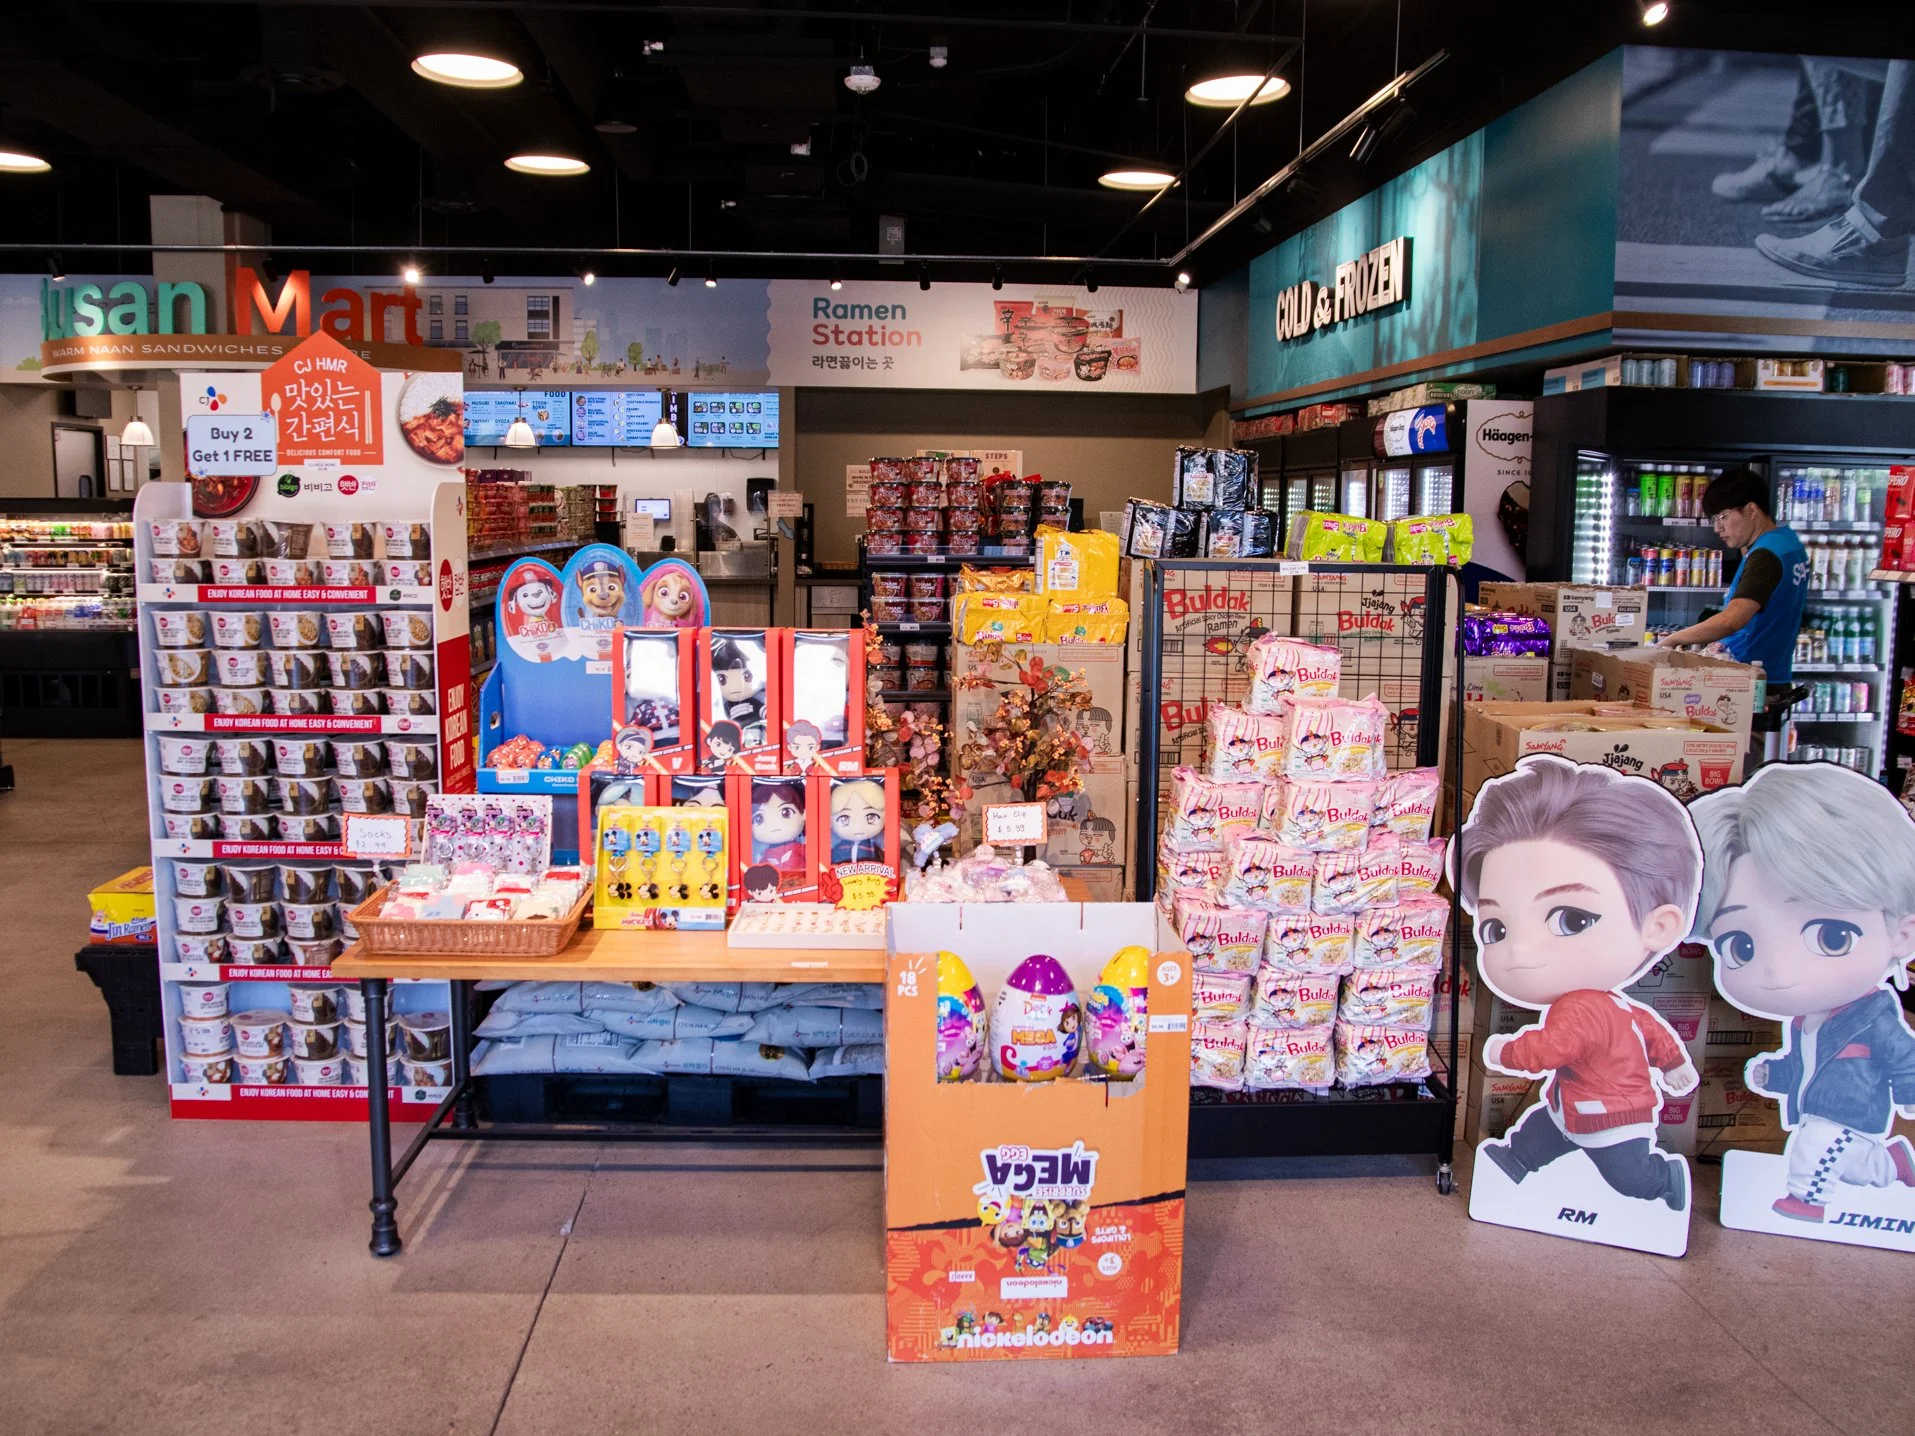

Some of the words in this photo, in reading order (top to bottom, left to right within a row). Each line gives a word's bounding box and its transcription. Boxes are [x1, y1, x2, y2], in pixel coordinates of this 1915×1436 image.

[1276, 280, 1312, 343] COLD
[1314, 286, 1331, 329] &
[1334, 236, 1414, 323] FROZEN
[236, 267, 424, 349] Mart
[812, 296, 907, 321] Ramen
[812, 323, 922, 347] Station
[52, 346, 85, 358] WARM
[89, 344, 133, 355] NAAN
[142, 344, 283, 355] SANDWICHES
[294, 360, 312, 374] CJ
[315, 357, 348, 373] HMR
[812, 354, 879, 371] 라면끓이는
[882, 355, 895, 370] 곳
[285, 379, 360, 411] 맛있는
[285, 411, 360, 442] 간편식
[211, 427, 239, 444] Buy
[243, 427, 254, 440] 2
[193, 450, 219, 462] Get
[223, 450, 230, 462] 1
[234, 450, 273, 462] FREE
[304, 482, 333, 493] 비비고
[207, 589, 227, 599] ENJOY
[229, 589, 254, 599] KOREAN
[256, 590, 273, 599] FOOD
[274, 590, 282, 599] AT
[283, 590, 302, 599] HOME
[303, 590, 320, 599] EASY
[322, 590, 326, 599] &
[327, 590, 368, 599] CONVENIENT
[1163, 585, 1250, 620] Buldak
[1175, 616, 1202, 633] Artificial
[1202, 614, 1216, 623] Spicy
[1206, 620, 1238, 634] Ramen
[1336, 610, 1396, 633] Buldak
[1297, 667, 1340, 683] Buldak
[1660, 676, 1693, 687] SAMYANG
[447, 683, 465, 712] ENJOY
[1685, 705, 1718, 718] Buldak
[214, 718, 233, 727] ENJOY
[235, 718, 260, 727] KOREAN
[262, 718, 278, 727] FOOD
[279, 718, 287, 728] AT
[289, 718, 307, 728] HOME
[309, 719, 325, 728] EASY
[327, 719, 332, 728] &
[333, 719, 373, 729] CONVENIENT
[445, 709, 468, 744] KOREAN
[1171, 729, 1198, 744] Artificial
[1526, 741, 1565, 751] SAMYANG
[450, 739, 465, 770] FOOD
[754, 755, 777, 764] Jung
[671, 757, 683, 770] V
[837, 760, 860, 772] RM
[1602, 752, 1644, 772] Jjajang
[1704, 777, 1725, 785] BOWL
[1710, 770, 1721, 778] BIG
[1219, 806, 1258, 821] Buldak
[1327, 807, 1369, 823] Buldak
[359, 827, 392, 840] Socks
[222, 845, 242, 854] ENJOY
[243, 845, 268, 854] KOREAN
[269, 845, 286, 854] FOOD
[287, 845, 295, 854] AT
[296, 845, 315, 855] HOME
[316, 845, 332, 855] EASY
[333, 846, 339, 855] &
[836, 866, 858, 879] NEW
[858, 864, 896, 878] ARRIVAL
[1272, 865, 1313, 879] Buldak
[1357, 865, 1399, 882] Buldak
[1401, 862, 1438, 881] Buldak
[105, 921, 123, 941] Jin
[1309, 923, 1352, 939] Buldak
[1401, 926, 1443, 940] Buldak
[1217, 932, 1260, 947] Buldak
[229, 969, 248, 977] ENJOY
[250, 969, 274, 977] KOREAN
[276, 969, 292, 978] FOOD
[293, 970, 301, 978] AT
[302, 970, 320, 978] HOME
[898, 971, 917, 986] 18
[1163, 973, 1175, 982] 3+
[897, 985, 919, 997] PCS
[1200, 991, 1243, 1004] Buldak
[1390, 984, 1431, 999] Buldak
[1677, 1023, 1690, 1031] BIG
[1011, 1030, 1057, 1046] MEGA
[1203, 1037, 1244, 1051] Buldak
[1384, 1033, 1426, 1050] Buldak
[1286, 1042, 1327, 1056] Buldak
[240, 1088, 259, 1097] ENJOY
[260, 1088, 285, 1097] KOREAN
[286, 1088, 303, 1097] FOOD
[303, 1088, 312, 1097] AT
[312, 1089, 331, 1098] HOME
[332, 1089, 348, 1098] EASY
[349, 1089, 354, 1098] &
[1491, 1084, 1528, 1093] SAMYANG
[1663, 1113, 1685, 1121] BOWL
[1001, 1147, 1028, 1160] EGG
[985, 1152, 1091, 1192] MEGA
[1035, 1186, 1088, 1198] SURPRISE
[1557, 1206, 1599, 1226] RM
[1829, 1211, 1915, 1234] JIMIN
[1095, 1226, 1118, 1236] GIFTS
[1119, 1226, 1127, 1234] &
[1091, 1233, 1132, 1244] LOLLIPOPS
[1103, 1255, 1117, 1264] 3+
[1006, 1279, 1063, 1288] nickelodeon
[957, 1325, 1114, 1349] nickelodeon
